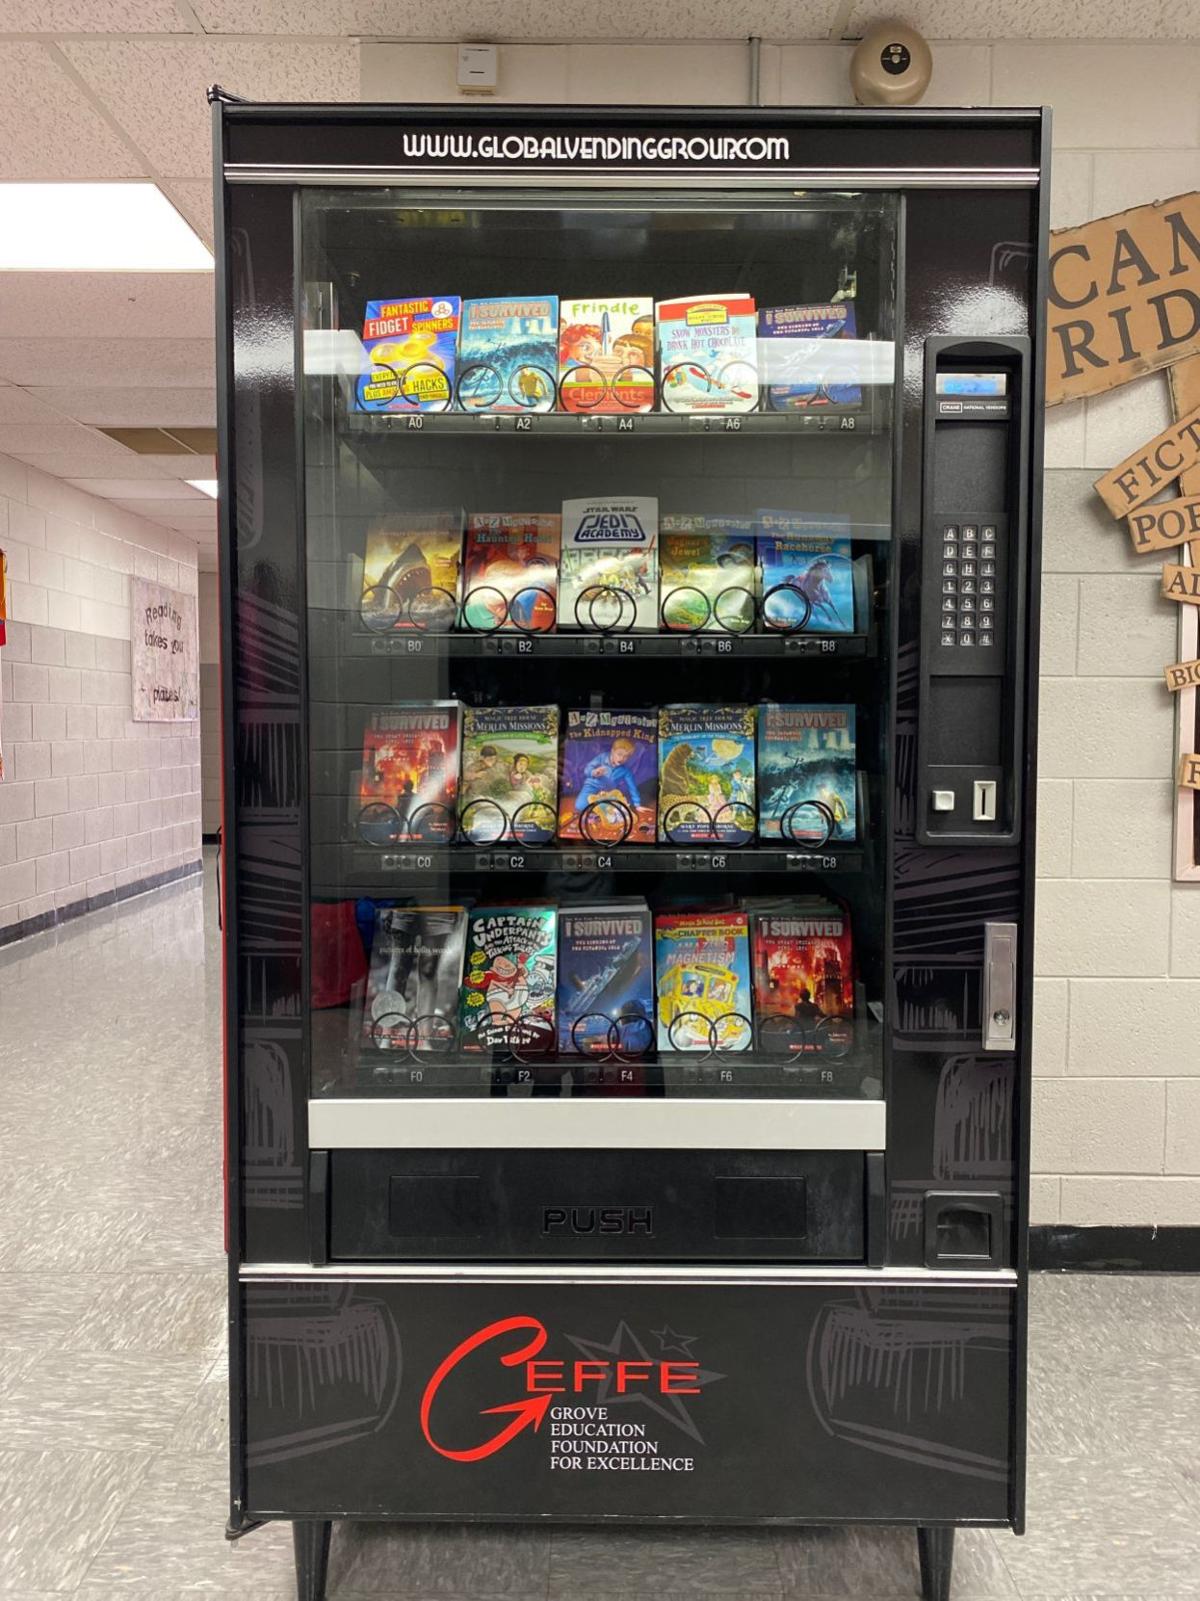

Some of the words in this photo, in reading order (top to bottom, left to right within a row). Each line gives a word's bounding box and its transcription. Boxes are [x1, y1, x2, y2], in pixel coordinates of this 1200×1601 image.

[381, 300, 429, 318] FANTASTIC
[572, 302, 639, 316] Frindle
[774, 307, 847, 324] SURVIVED
[369, 317, 408, 337] FIDGET
[412, 318, 454, 334] SPINNERS
[413, 378, 445, 392] HACKS
[408, 418, 423, 429] A0
[516, 419, 531, 430] A2
[618, 419, 633, 430] A4
[725, 419, 741, 430] A6
[840, 418, 855, 430] A8
[581, 529, 640, 538] ACADEMY
[946, 528, 955, 538] A
[966, 528, 974, 538] B
[985, 528, 992, 538] C
[946, 546, 954, 555] D
[966, 546, 973, 555] E
[946, 563, 953, 573] G
[965, 563, 972, 573] H
[947, 581, 954, 590] 1
[965, 581, 972, 591] 2
[984, 581, 991, 591] 3
[945, 599, 953, 608] 4
[964, 599, 971, 608] 5
[983, 599, 990, 608] 6
[145, 602, 182, 631] Reading
[964, 616, 971, 625] 8
[983, 616, 990, 625] 9
[145, 630, 168, 650] takes
[963, 634, 970, 643] 0
[407, 640, 422, 652] B0
[518, 641, 533, 653] B2
[620, 641, 634, 652] B4
[718, 641, 732, 652] B6
[821, 640, 836, 652] B8
[381, 714, 449, 730] SURVIVED
[509, 720, 546, 731] MISSIONS
[775, 712, 847, 729] SURVIVED
[671, 722, 702, 733] MERLIN
[705, 721, 742, 731] MISSIONS
[417, 856, 431, 868] C0
[510, 856, 524, 868] C2
[598, 856, 612, 868] C4
[711, 856, 726, 868] C6
[822, 857, 837, 868] C8
[472, 916, 546, 933] CAPTAIN
[565, 921, 571, 937] I
[574, 919, 643, 936] SURVIVED
[762, 921, 768, 937] I
[771, 921, 843, 937] SURVIVED
[472, 926, 552, 947] UNDERPANTS
[718, 928, 744, 936] BOOK
[667, 952, 735, 964] MAGNETISM
[410, 1071, 423, 1082] F0
[518, 1071, 530, 1082] F2
[620, 1071, 634, 1082] F4
[720, 1071, 733, 1082] F6
[820, 1071, 834, 1082] F8
[543, 1207, 654, 1236] PUSH
[551, 1407, 608, 1420] GROVE
[551, 1424, 645, 1437] EDUCATION
[551, 1441, 658, 1454] FOUNDATION
[551, 1457, 583, 1470] FOR
[587, 1457, 694, 1471] EXCELLENCE
